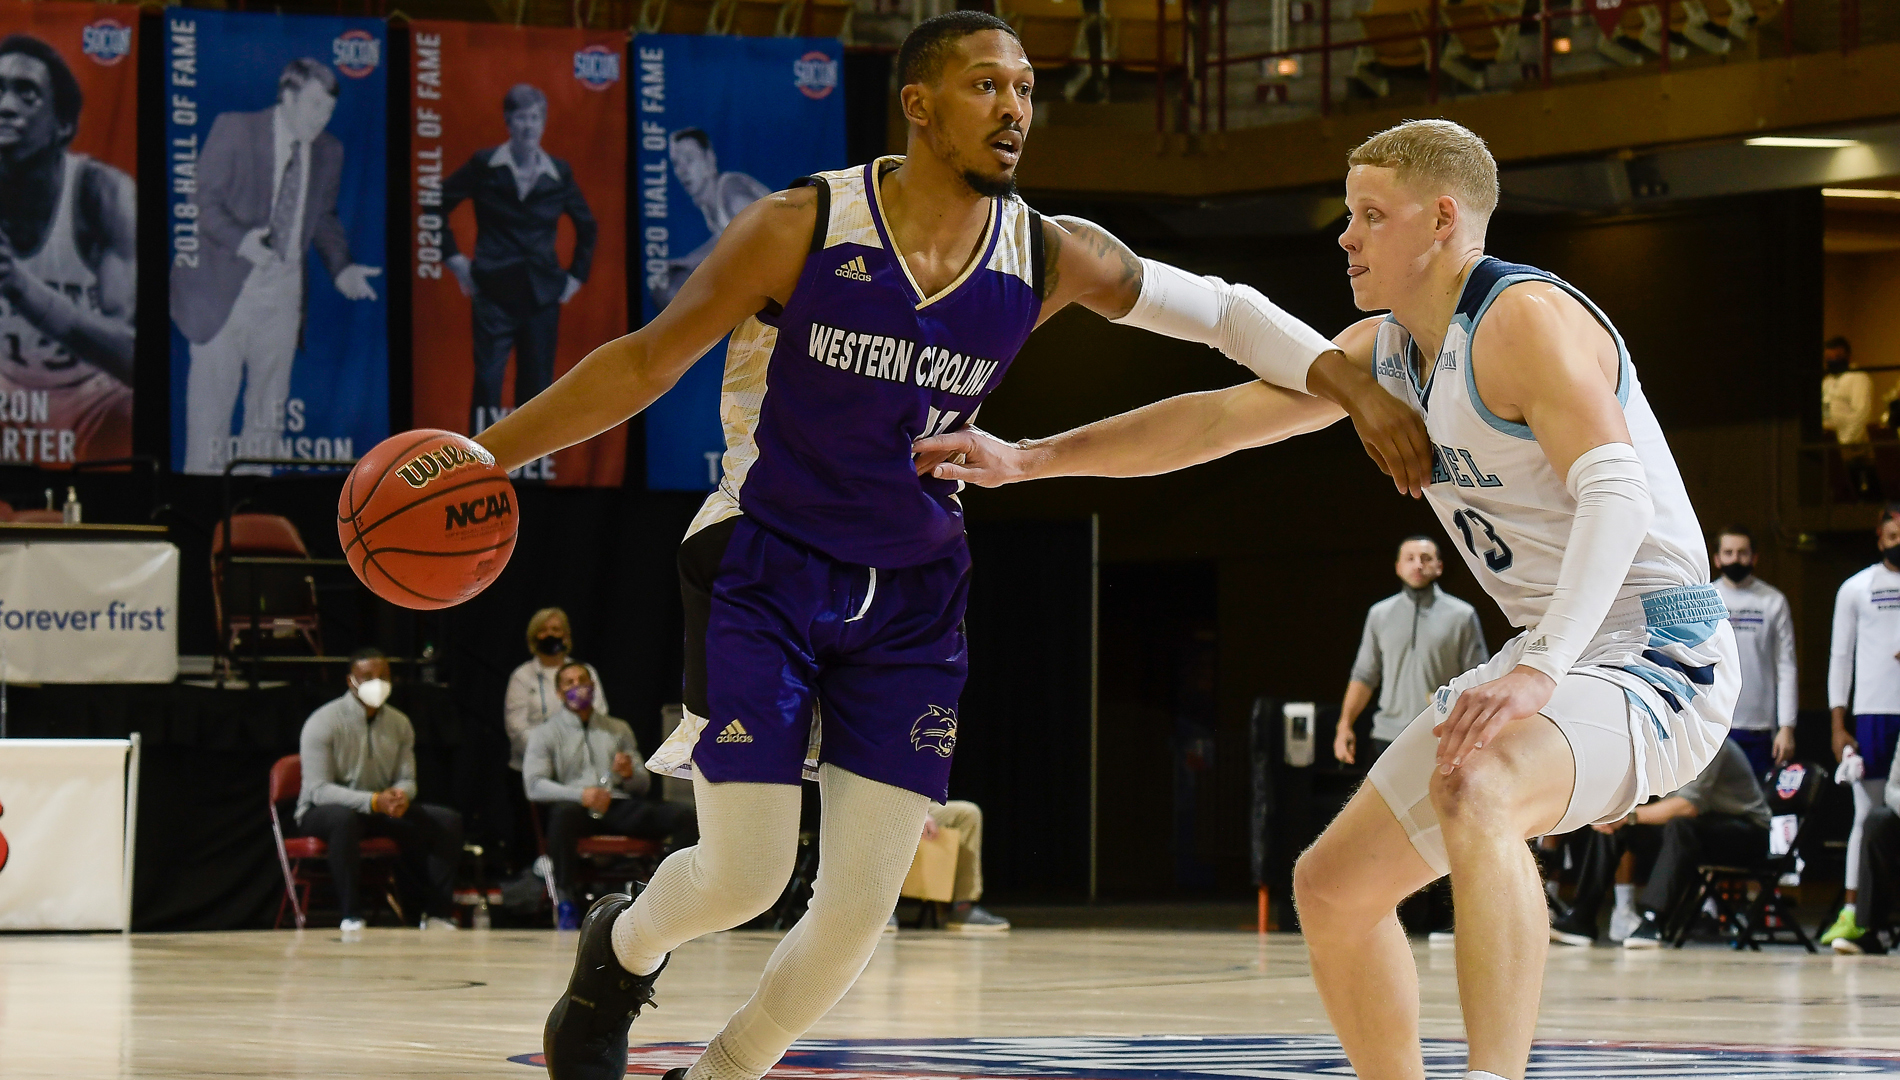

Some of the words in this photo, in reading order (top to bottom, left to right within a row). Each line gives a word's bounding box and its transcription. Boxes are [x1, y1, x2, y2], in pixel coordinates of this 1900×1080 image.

[82, 25, 132, 56] SOCON
[170, 19, 197, 87] FAME
[333, 37, 381, 67] SOCON
[416, 33, 441, 100] FAME
[573, 51, 620, 81] SOCON
[639, 47, 665, 113] FAME
[172, 94, 198, 126] OF
[416, 106, 442, 138] OF
[641, 120, 667, 151] OF
[172, 133, 198, 194] HALL
[417, 146, 443, 206] HALL
[643, 158, 668, 218] HALL
[173, 202, 200, 269] 2018
[417, 213, 443, 279] 2020
[645, 226, 669, 290] 2020
[835, 266, 872, 282] adidas
[808, 322, 915, 383] WESTERN
[915, 345, 999, 397] CAROLINA
[1378, 366, 1407, 381] adidas
[445, 491, 513, 531] NCAA
[1453, 508, 1514, 574] 13
[0, 600, 101, 631] orever
[107, 600, 165, 631] first
[716, 733, 754, 744] adidas
